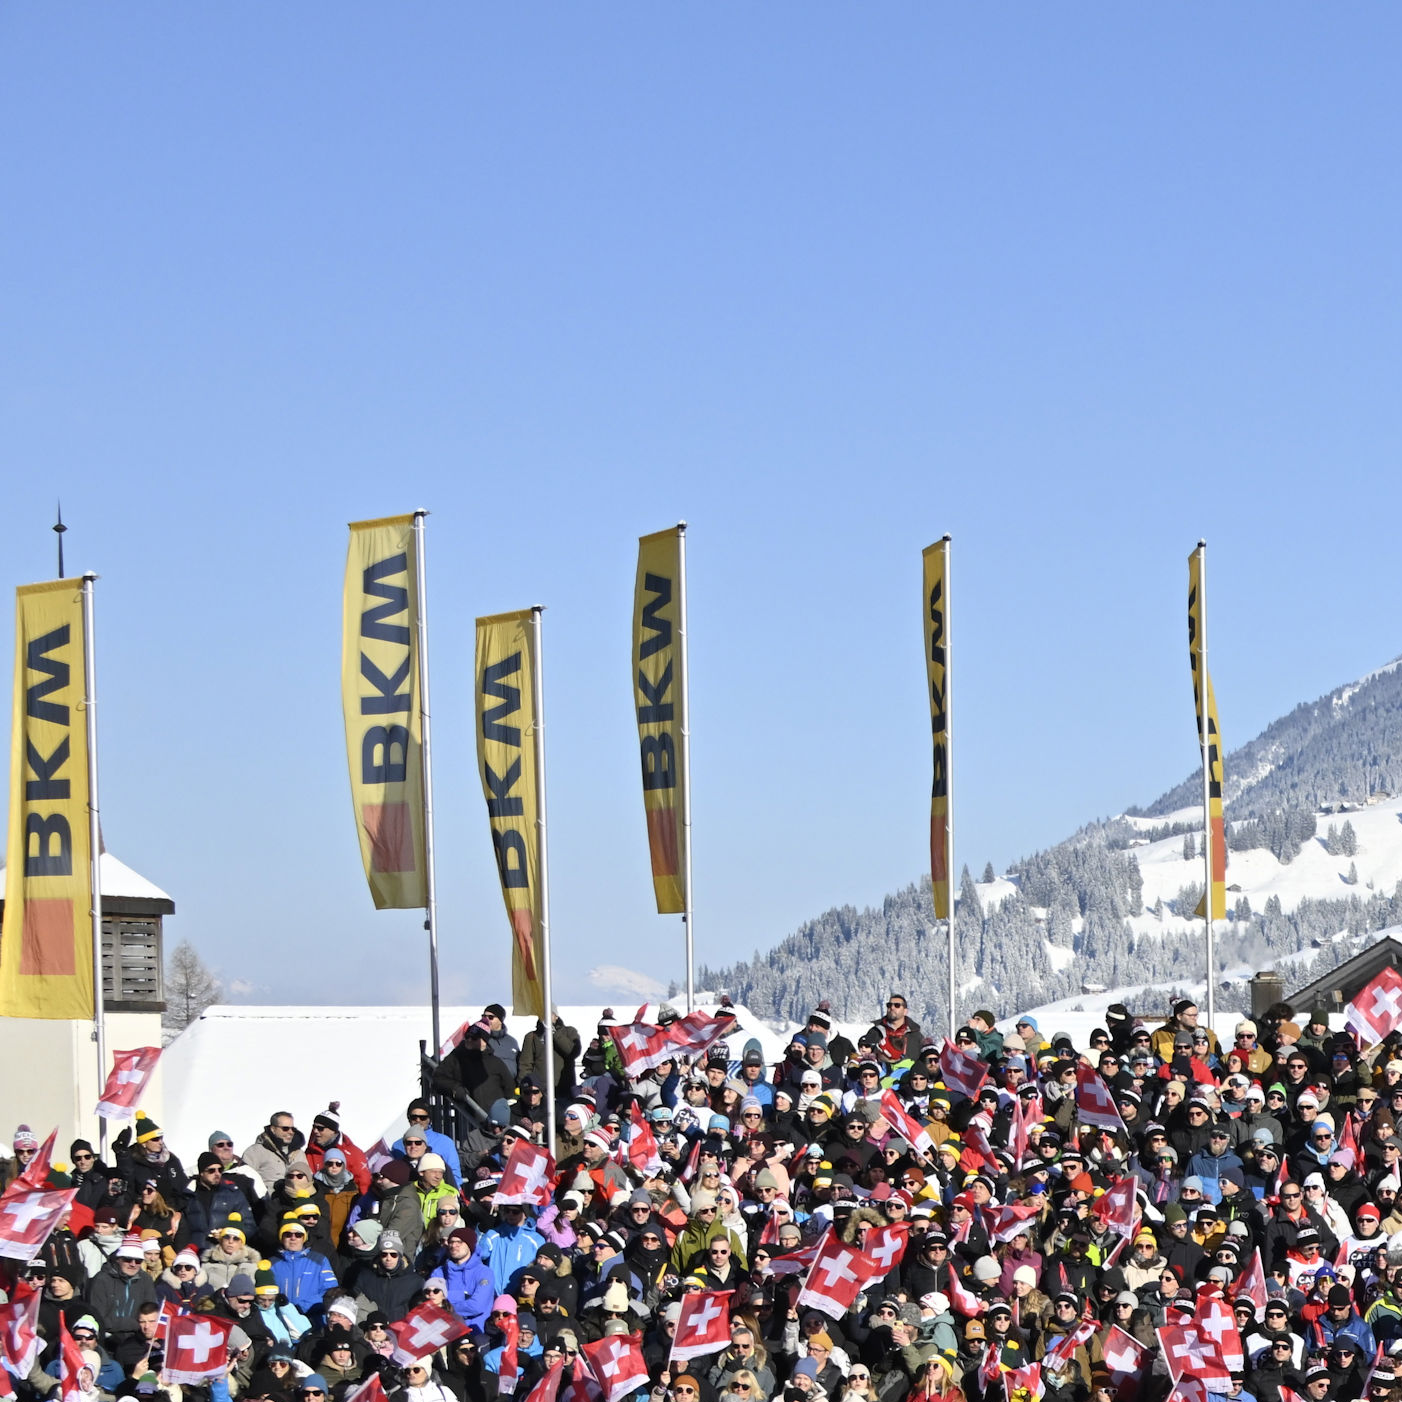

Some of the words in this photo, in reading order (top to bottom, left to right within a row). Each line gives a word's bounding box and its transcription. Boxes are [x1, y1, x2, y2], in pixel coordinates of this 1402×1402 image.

[24, 622, 73, 878] BKW
[361, 551, 412, 785] BKW
[481, 650, 529, 890] BKW
[638, 572, 677, 791] BKW
